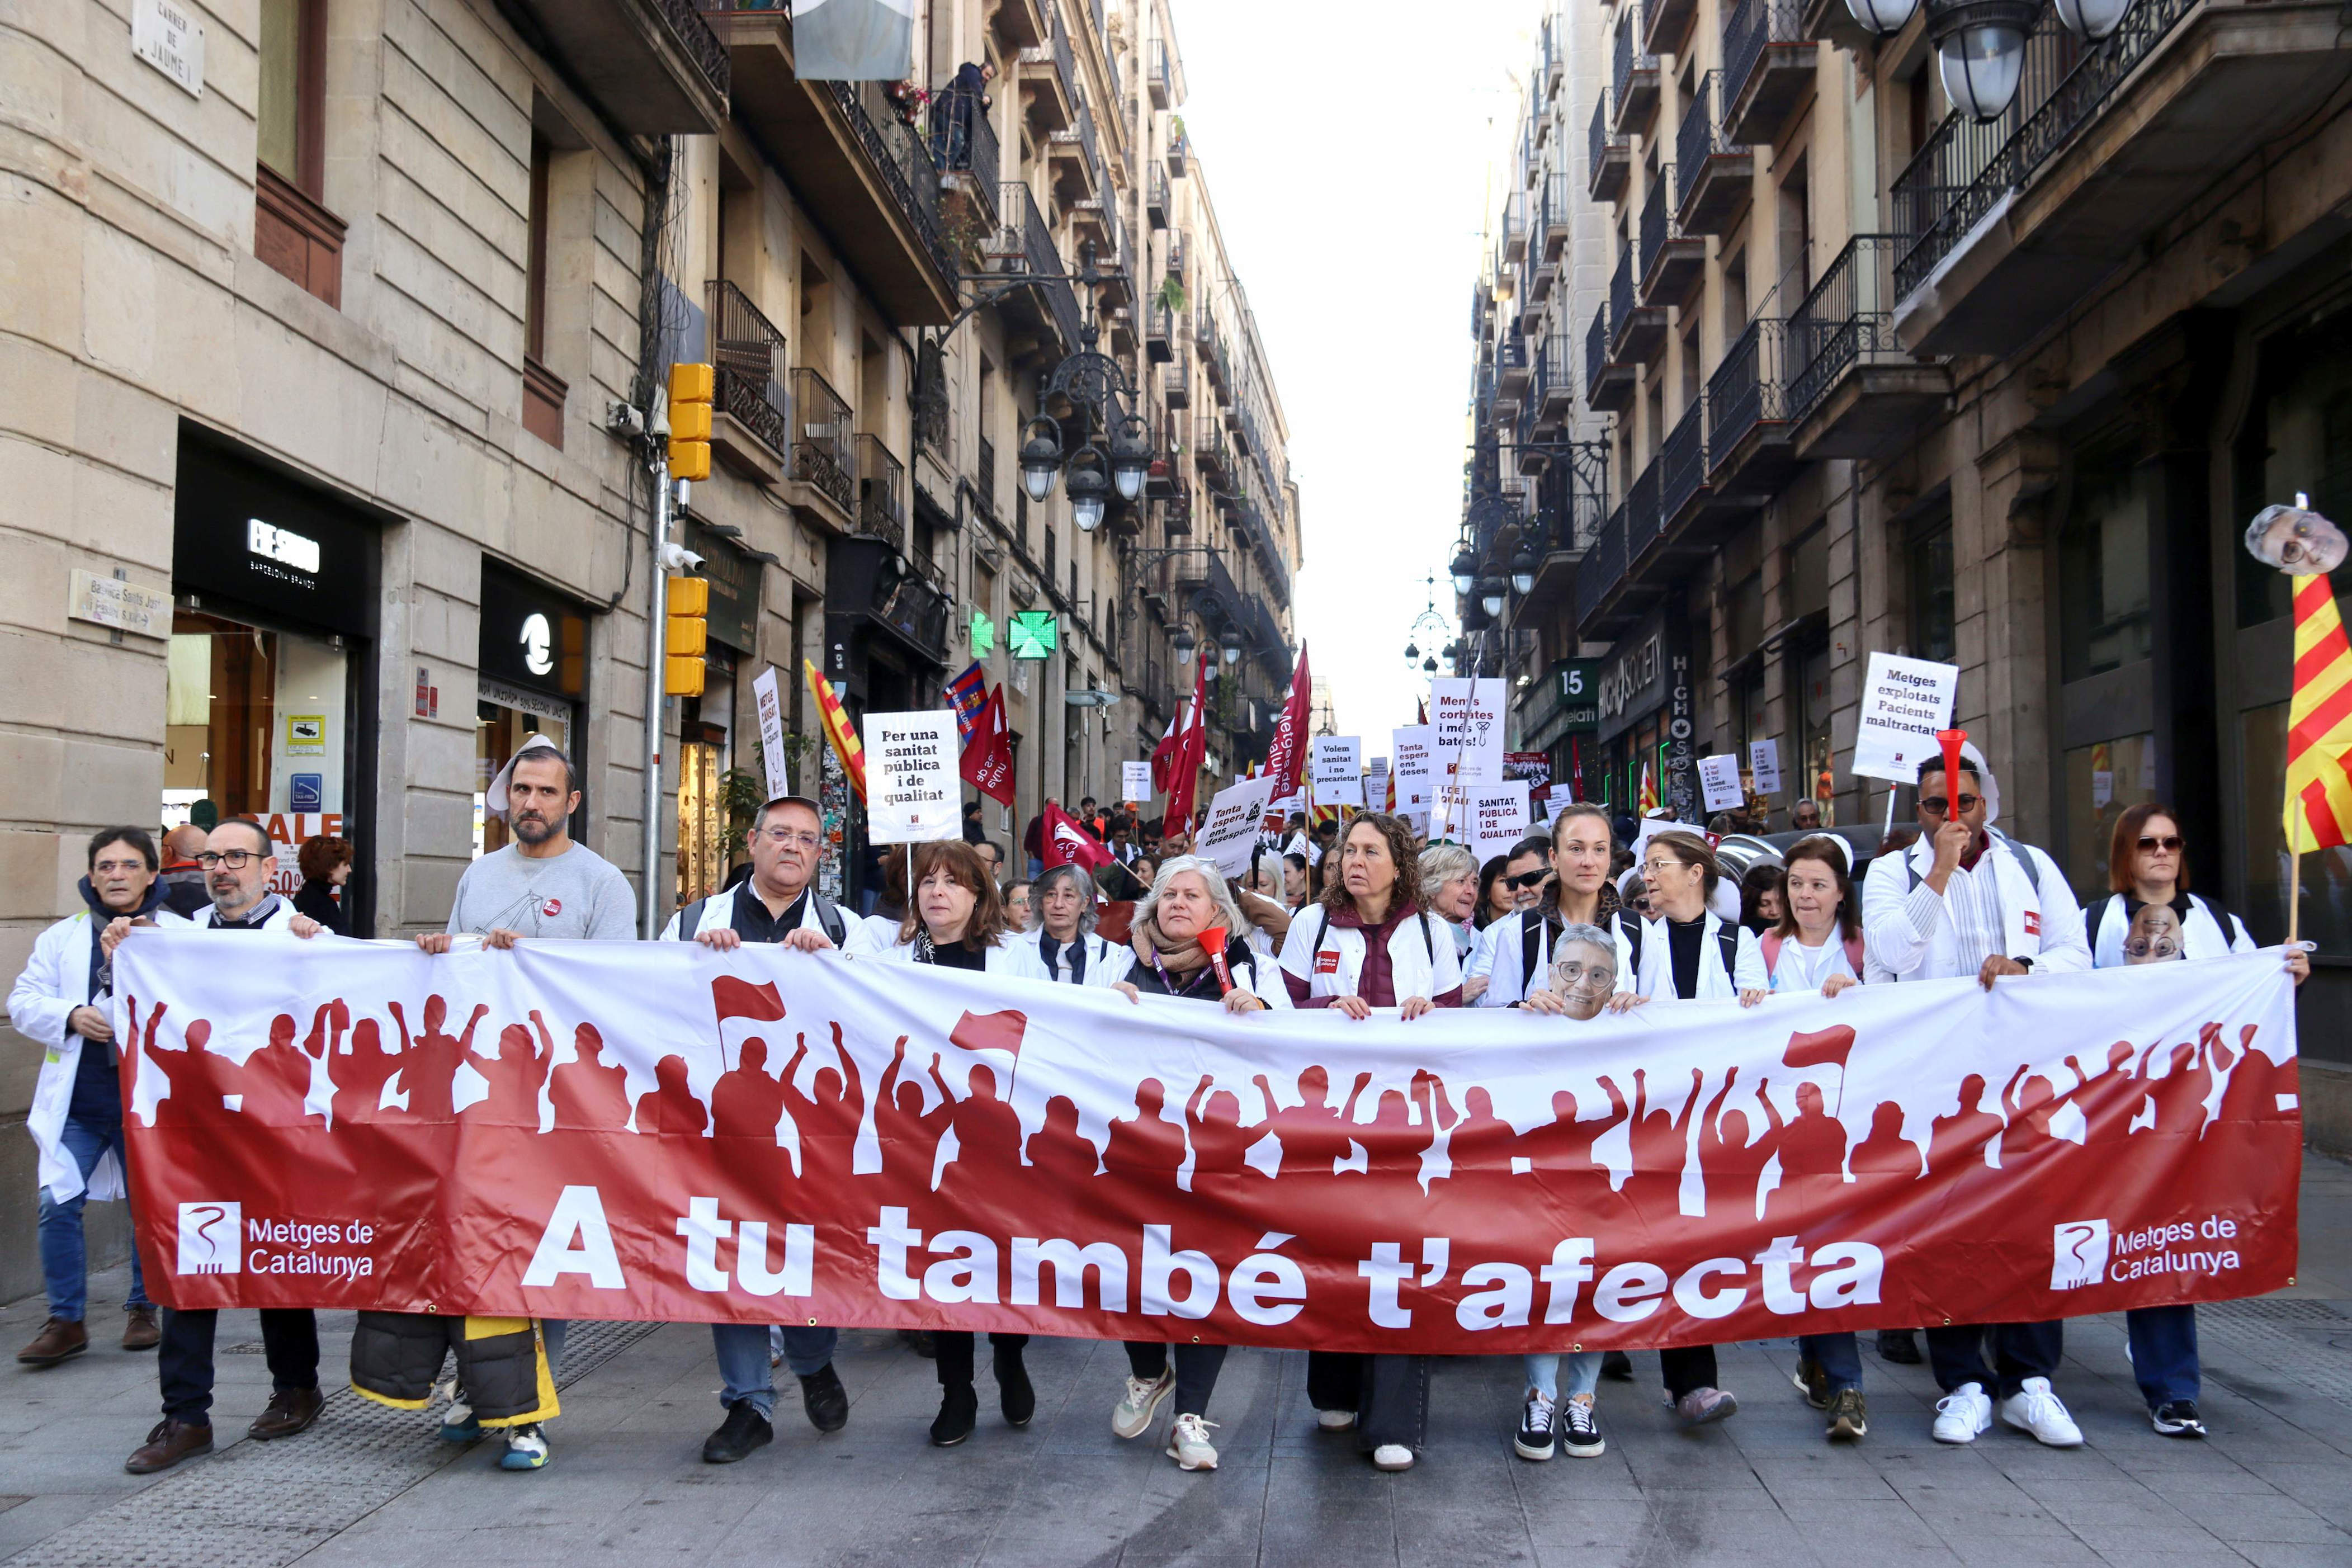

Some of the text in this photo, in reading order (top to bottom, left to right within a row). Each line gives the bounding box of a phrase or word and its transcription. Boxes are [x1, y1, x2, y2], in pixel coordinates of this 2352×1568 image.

[157, 1, 187, 33] CARRER
[167, 30, 177, 49] DE
[152, 40, 191, 84] JAUME I
[251, 560, 315, 591] BARCELONA BRANDS
[122, 588, 143, 606] Sants
[1561, 670, 1583, 695] 15
[1598, 632, 1662, 721] HIGH SOCIETY
[1887, 669, 1937, 687] Metges
[1673, 656, 1688, 716] HIGH
[760, 689, 774, 710] METGE
[1878, 686, 1940, 705] explotats
[531, 698, 550, 715] SECOND
[952, 693, 973, 733] BARCELONA
[1878, 700, 1935, 720] Pacients
[1566, 707, 1595, 725] elati
[882, 730, 938, 742] Per una
[1439, 723, 1442, 733] i
[885, 744, 937, 757] sanitat
[1279, 706, 1294, 792] Metges de
[1399, 744, 1423, 752] Tanta
[1399, 752, 1429, 761] espera
[884, 759, 941, 775] pública
[898, 774, 924, 787] i de
[1316, 775, 1358, 784] precarietat
[884, 790, 944, 806] qualitat
[1479, 797, 1517, 807] SANITAT,
[1212, 813, 1245, 828] espera
[1216, 805, 1242, 819] Tanta
[1479, 807, 1518, 819] PÚBLICA
[239, 813, 342, 845] ALE
[1209, 827, 1227, 838] ens
[1479, 828, 1523, 839] QUALITAT
[1485, 820, 1498, 829] DE
[1205, 825, 1255, 847] desespera
[249, 1218, 374, 1249] Metges de
[2115, 1215, 2236, 1255] Metges de
[248, 1248, 374, 1282] Catalunya
[521, 1185, 1884, 1331] A tu també t'afecta
[2110, 1249, 2240, 1282] Catalunya
